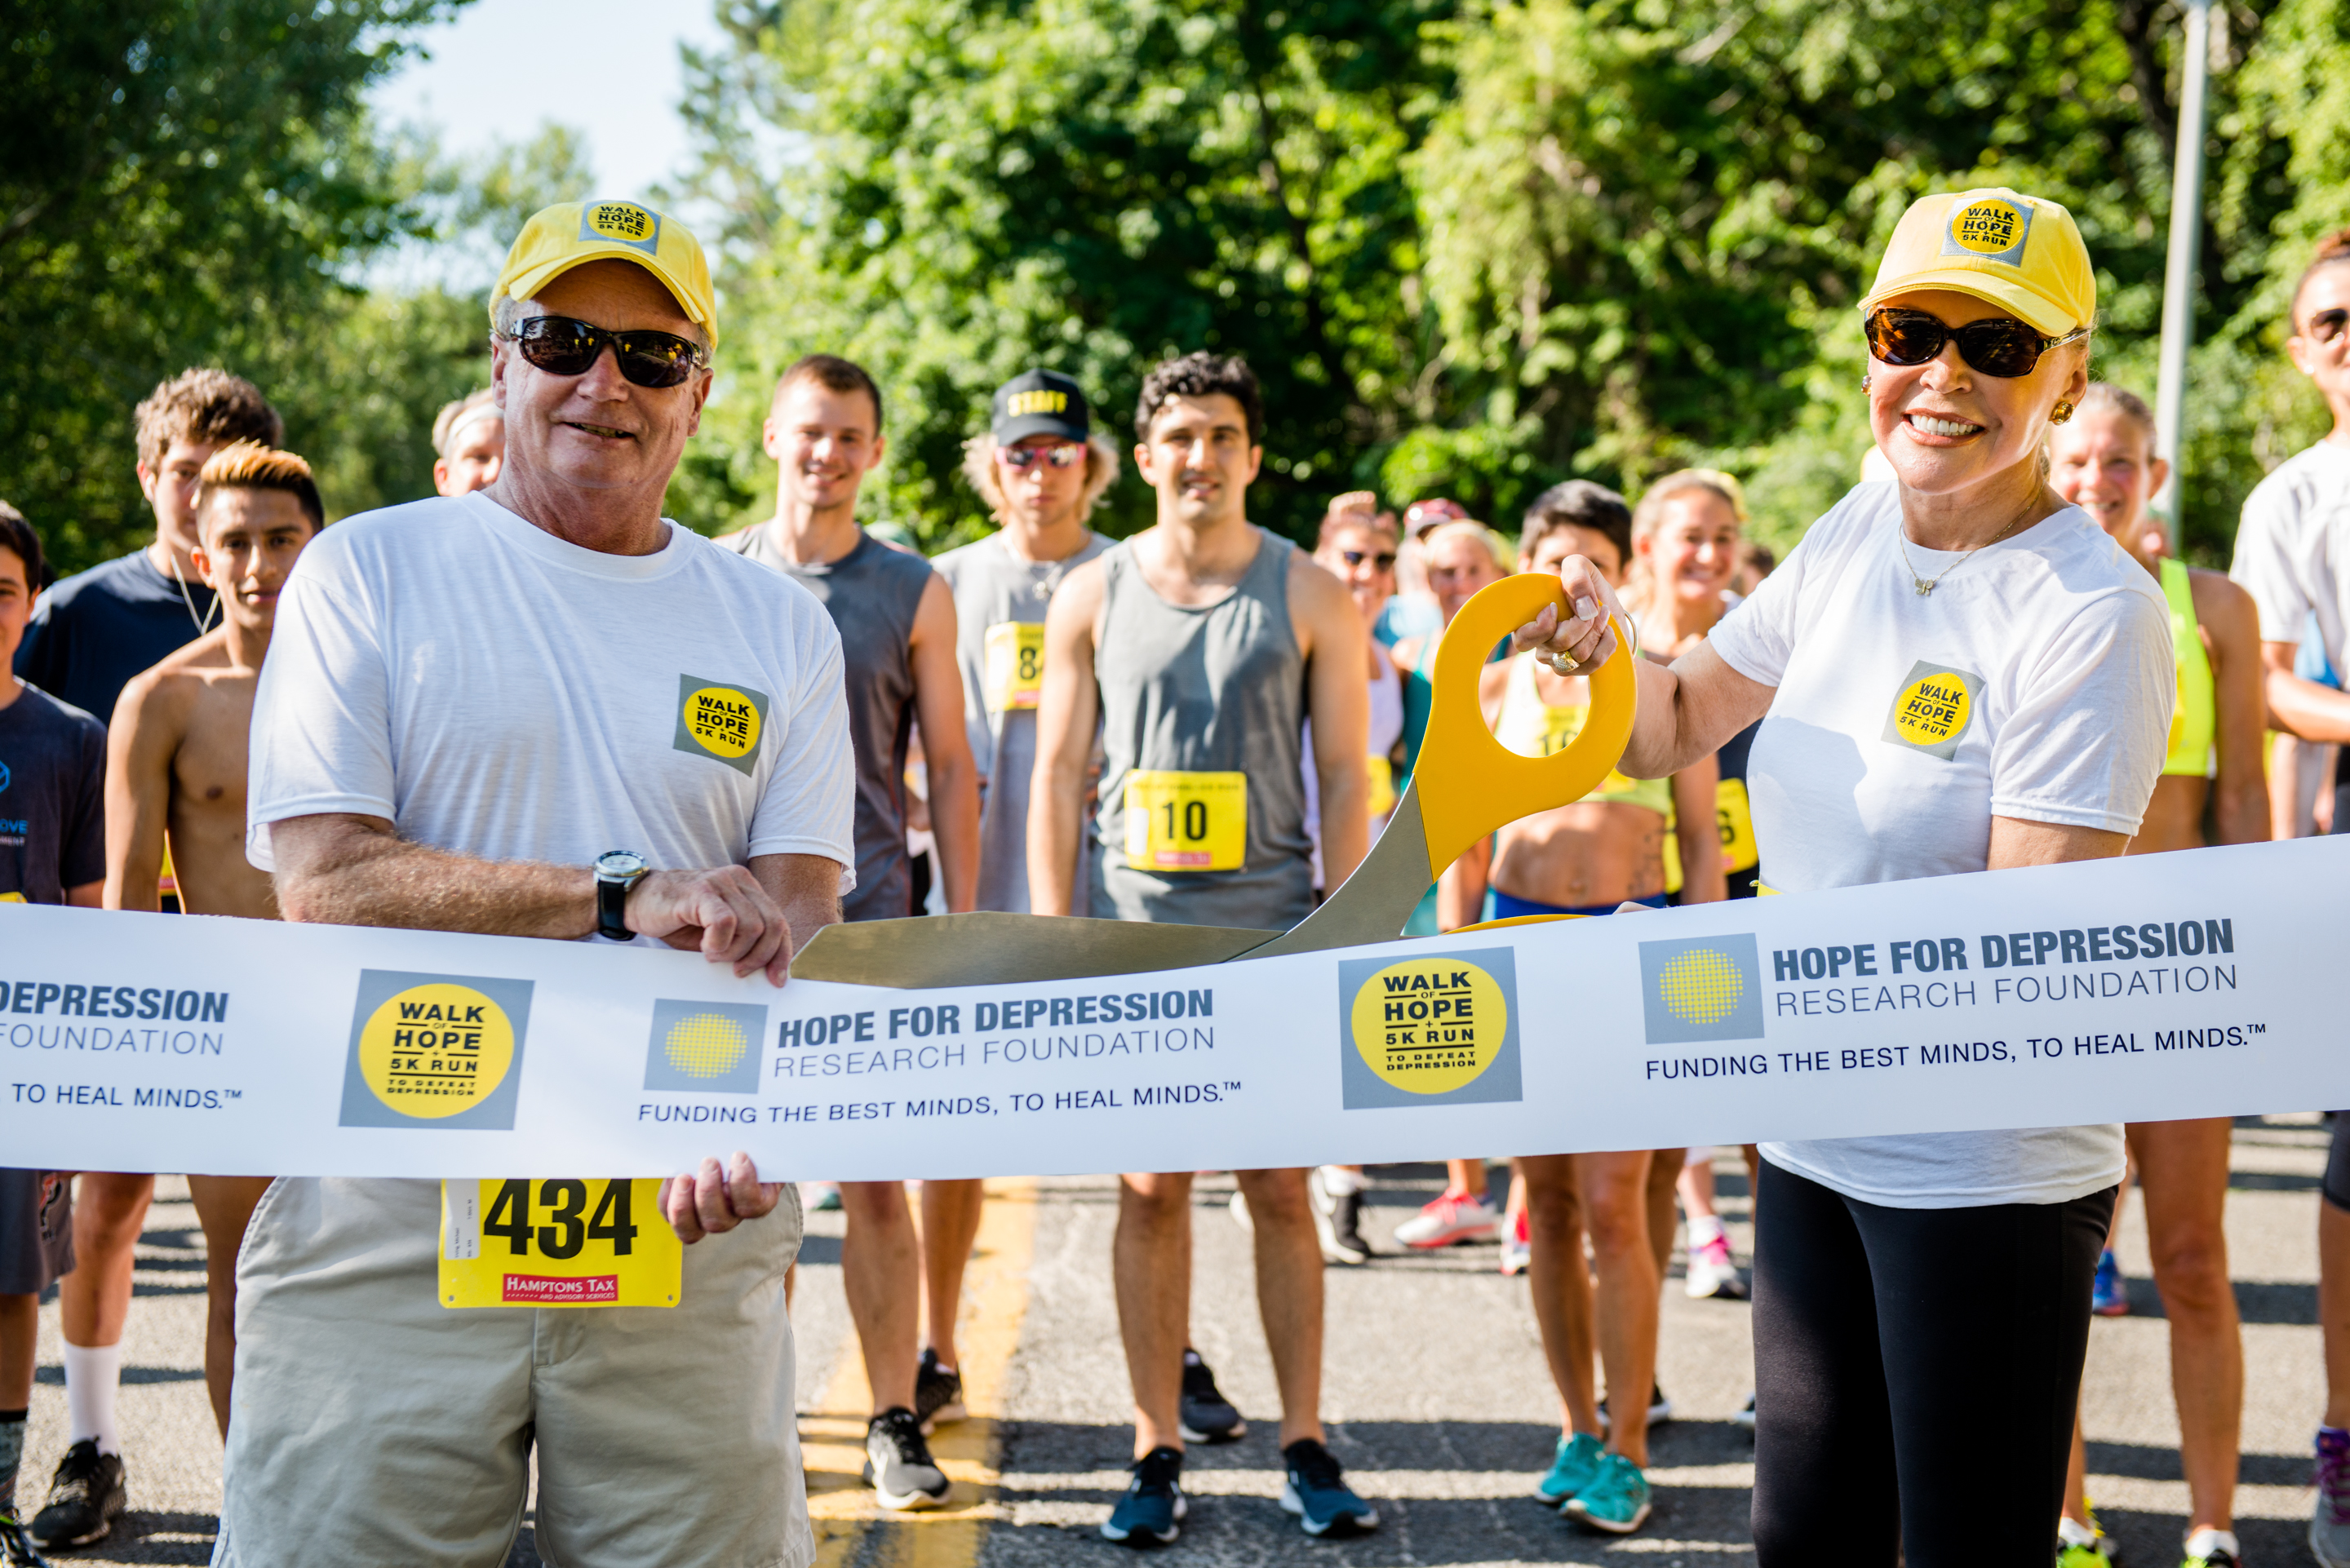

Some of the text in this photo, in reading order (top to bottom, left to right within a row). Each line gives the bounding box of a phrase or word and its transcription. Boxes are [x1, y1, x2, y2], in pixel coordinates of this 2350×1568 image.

[598, 214, 645, 229] HOPE
[601, 206, 645, 219] WALK
[1967, 208, 2015, 222] WALK
[618, 225, 641, 237] RUN
[1963, 220, 2013, 236] HOPE
[1982, 235, 2007, 246] RUN
[1919, 683, 1963, 705] WALK
[698, 695, 750, 718] WALK
[1907, 699, 1956, 724] HOPE
[697, 711, 748, 735] HOPE
[1900, 716, 1948, 737] 5K RUN
[695, 727, 745, 749] 5K RUN
[1162, 800, 1207, 841] 10
[1772, 918, 2234, 981] HOPE FOR DEPRESSION
[1383, 971, 1472, 992] WALK
[1776, 964, 2237, 1017] RESEARCH FOUNDATION
[400, 1002, 486, 1023] WALK
[778, 989, 1213, 1048] HOPE FOR DEPRESSION
[1384, 998, 1473, 1021] HOPE
[393, 1030, 482, 1050] HOPE
[1386, 1029, 1474, 1045] 5K RUN
[774, 1026, 1213, 1078] RESEARCH FOUNDATION
[1414, 1051, 1475, 1061] DEFEAT
[1646, 1054, 1767, 1079] FUNDING
[1777, 1051, 1830, 1073] THE
[1841, 1047, 1909, 1070] BEST
[1920, 1040, 2016, 1065] MINDS,
[2027, 1038, 2063, 1058] TO
[2074, 1033, 2144, 1056] HEAL
[390, 1058, 478, 1072] 5K RUN
[1386, 1060, 1476, 1071] DEPRESSION
[387, 1087, 475, 1096] DEPRESSION
[415, 1079, 477, 1087] DEFEAT
[11, 1083, 46, 1103] TO
[56, 1085, 123, 1105] HEAL
[638, 1104, 756, 1123] FUNDING
[767, 1105, 818, 1123] THE
[829, 1101, 896, 1121] BEST
[905, 1096, 998, 1118] MINDS,
[1009, 1093, 1044, 1111] TO
[1055, 1089, 1123, 1110] HEAL
[483, 1178, 638, 1260] 434
